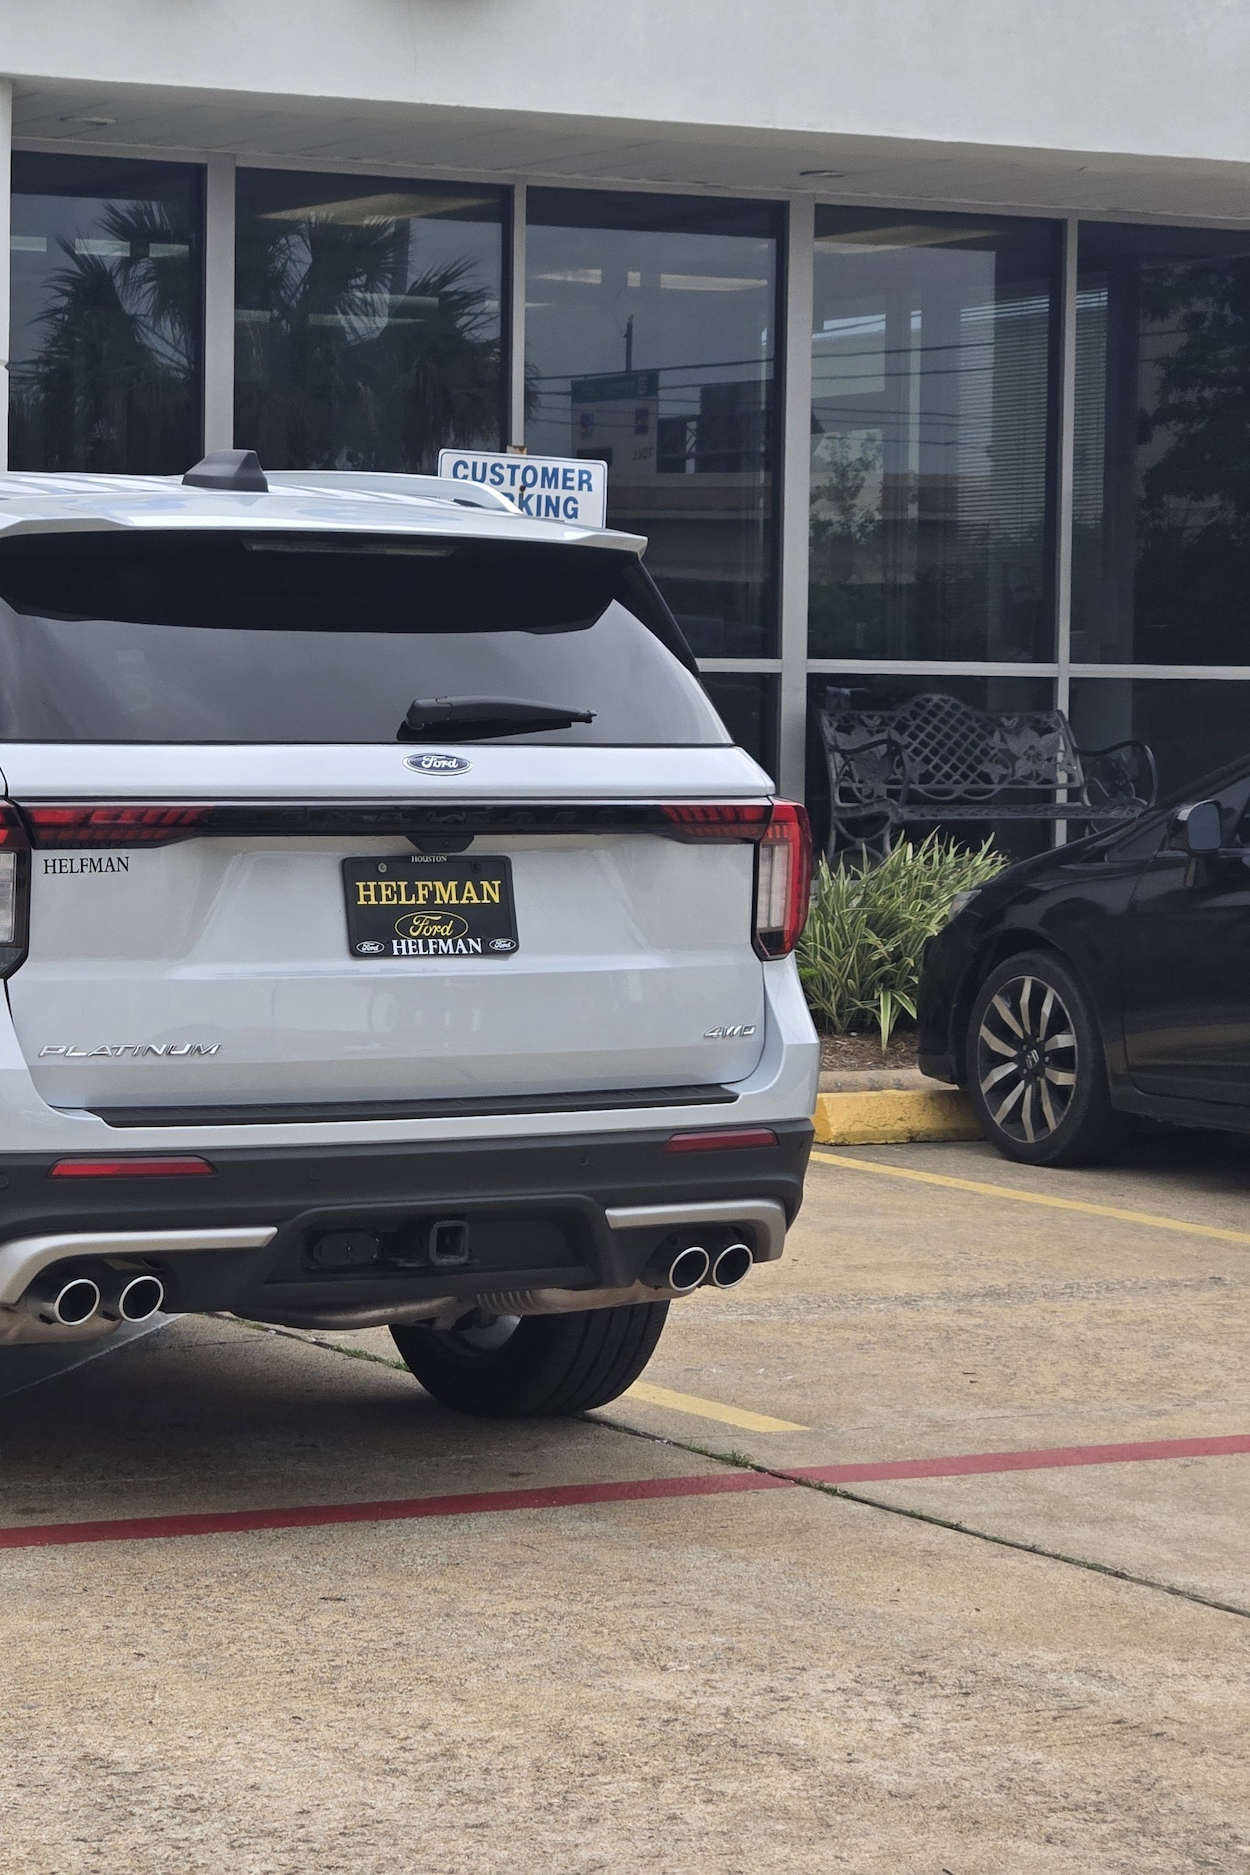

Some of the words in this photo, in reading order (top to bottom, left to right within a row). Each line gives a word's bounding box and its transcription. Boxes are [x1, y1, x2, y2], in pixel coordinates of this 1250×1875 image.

[452, 459, 593, 492] CUSTOMER
[44, 857, 129, 874] HELFMAN
[411, 855, 447, 863] HOUSTON
[355, 881, 501, 905] HELFMAN
[409, 915, 453, 937] Ford
[392, 938, 482, 956] HELFMAN
[703, 1025, 756, 1039] 4WD
[38, 1043, 222, 1057] PLATINUM
